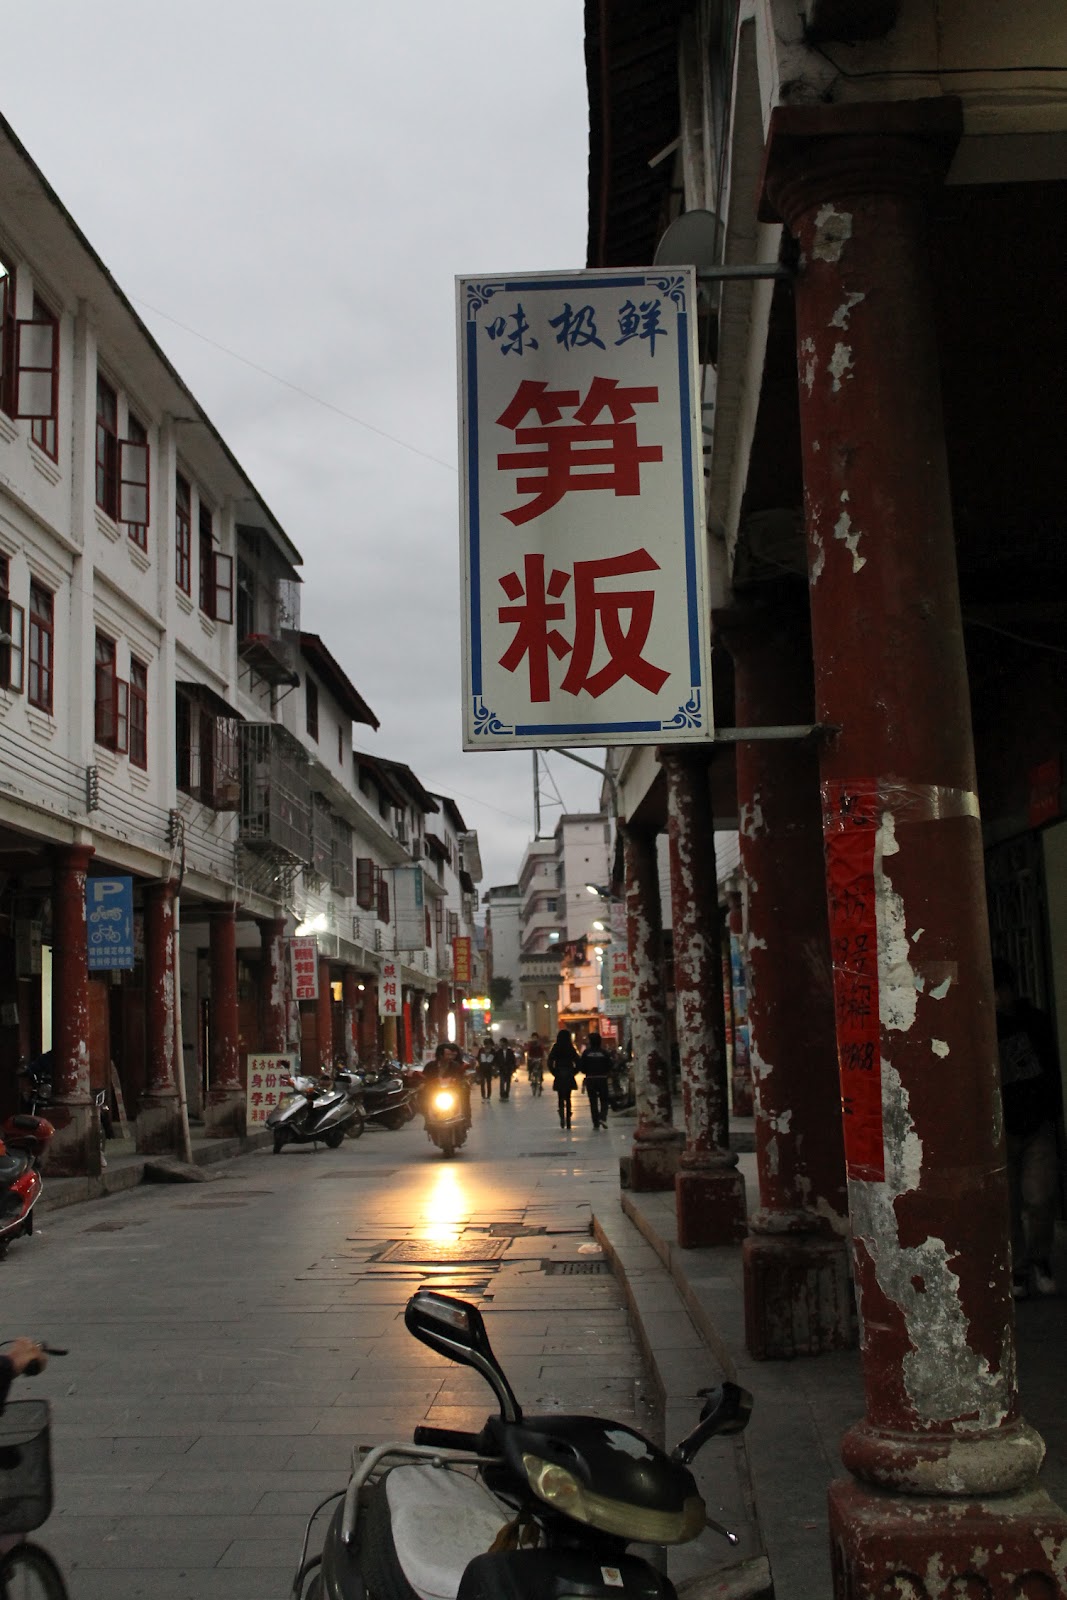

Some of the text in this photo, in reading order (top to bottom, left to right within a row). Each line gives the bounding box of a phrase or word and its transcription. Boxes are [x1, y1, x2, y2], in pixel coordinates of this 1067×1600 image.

[485, 299, 668, 357] 味极鲜
[495, 376, 671, 702] 笋粄
[94, 881, 124, 902] P
